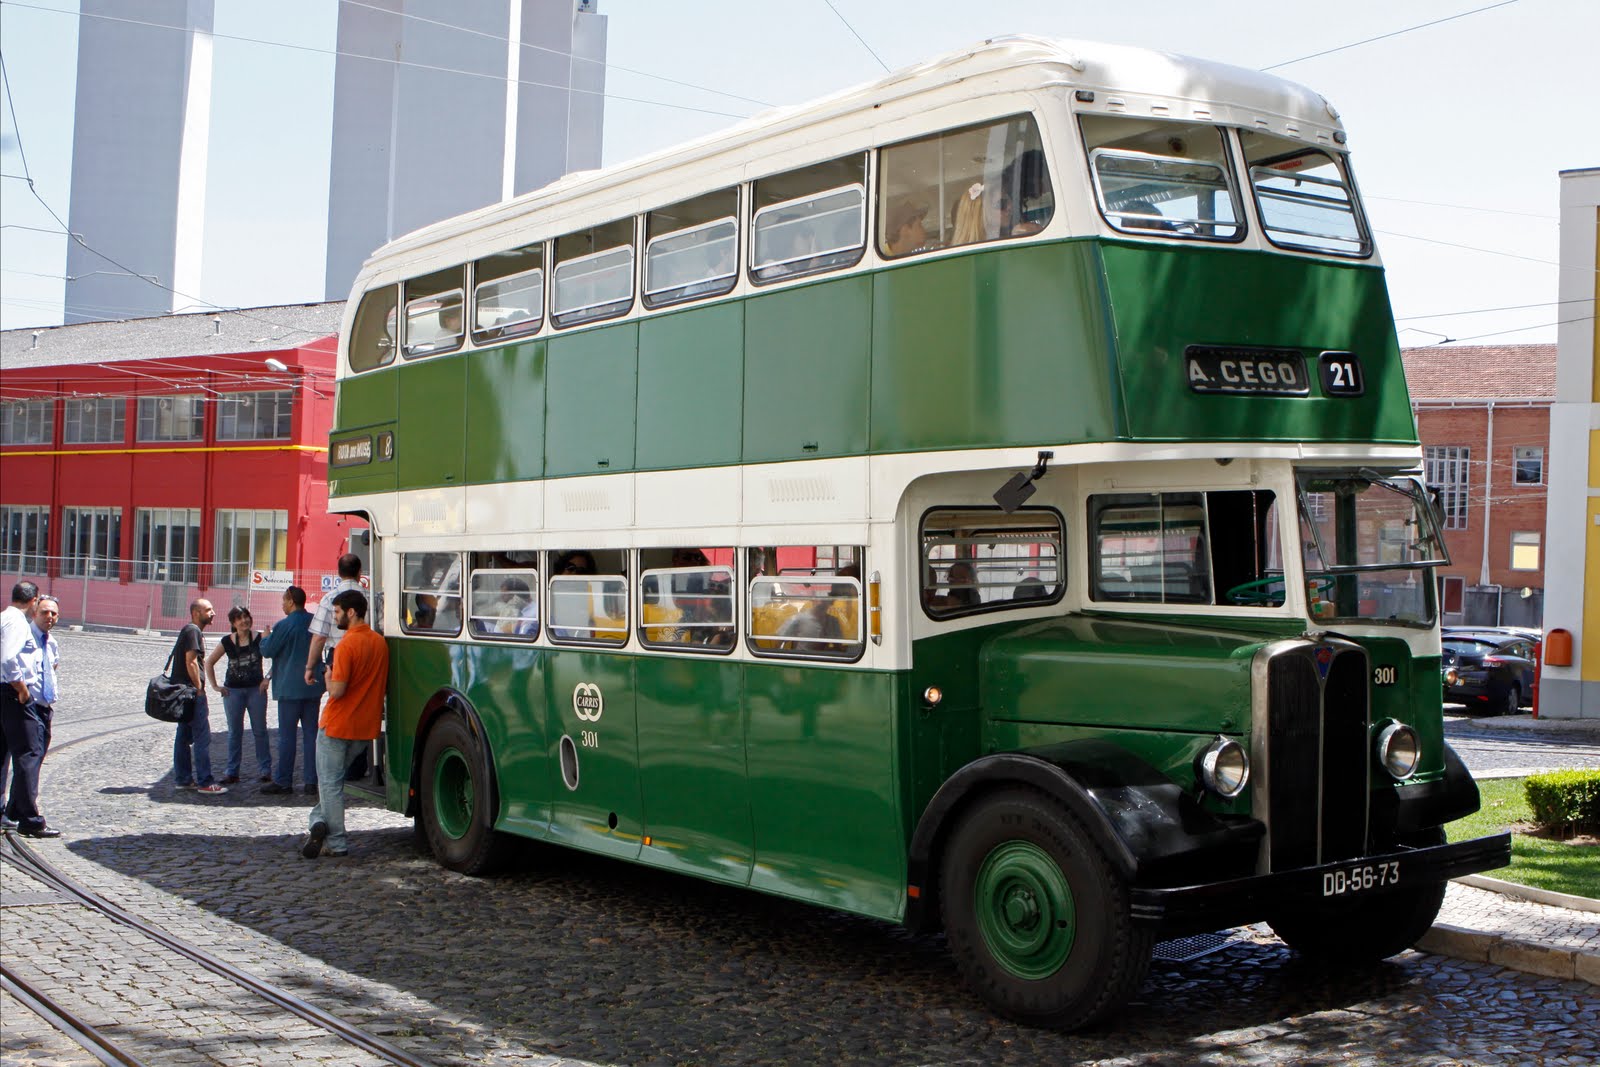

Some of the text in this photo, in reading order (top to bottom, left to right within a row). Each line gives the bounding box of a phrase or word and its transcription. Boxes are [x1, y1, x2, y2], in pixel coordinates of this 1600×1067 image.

[1189, 359, 1297, 385] A. CEGO
[1330, 362, 1355, 387] 21
[1374, 667, 1395, 685] 301
[577, 696, 599, 708] CARRIS
[581, 730, 599, 748] 301
[1323, 861, 1399, 896] DD-56-73
